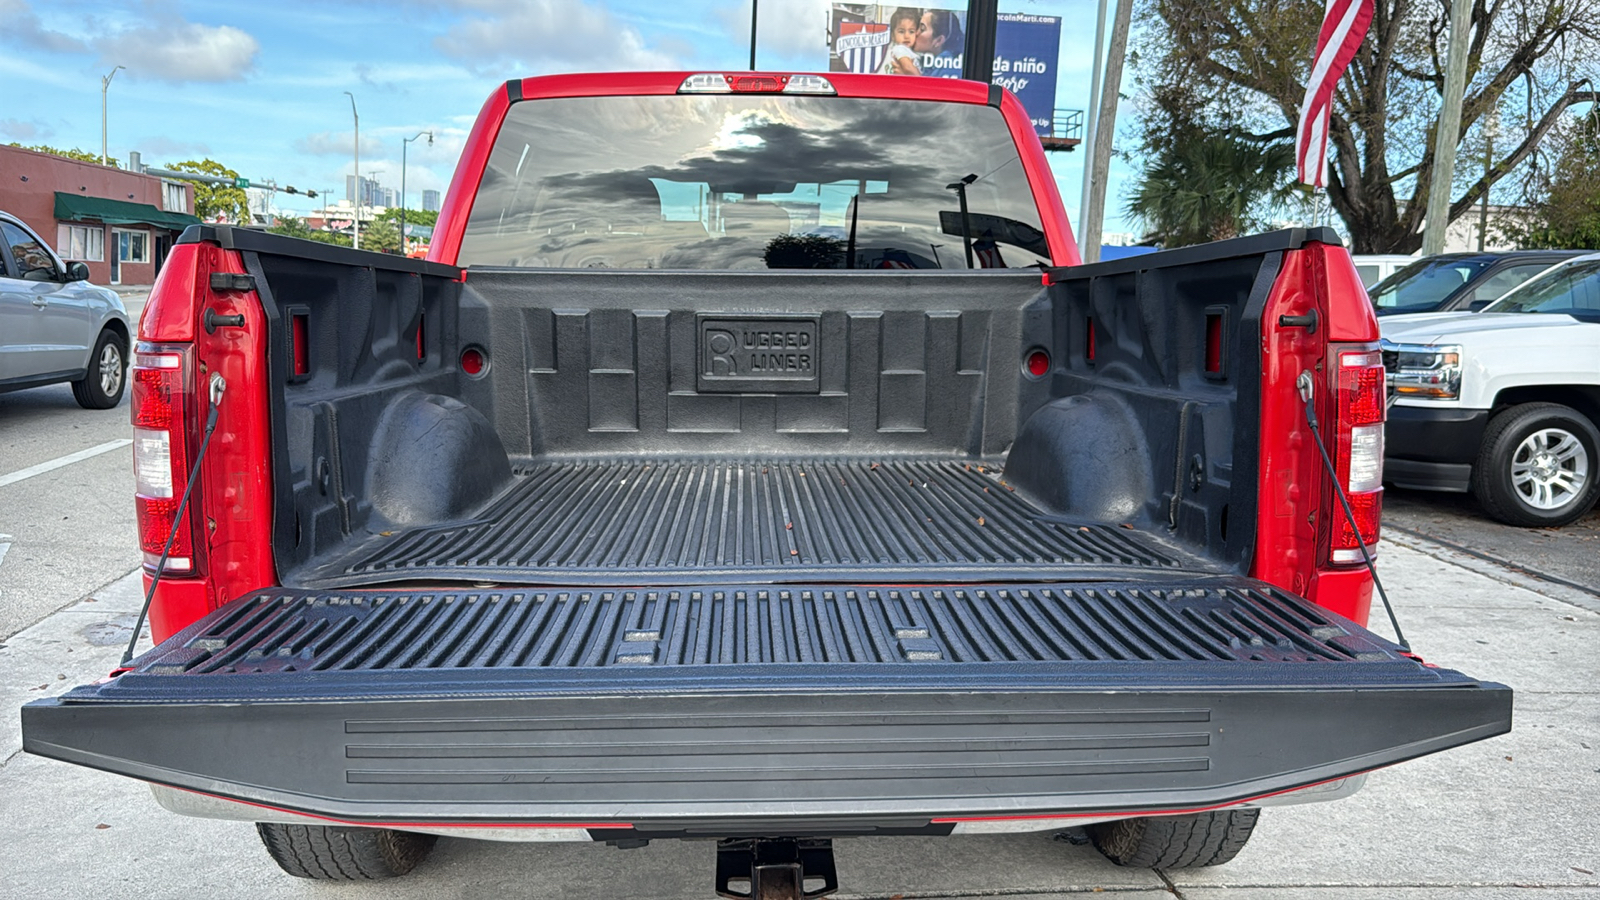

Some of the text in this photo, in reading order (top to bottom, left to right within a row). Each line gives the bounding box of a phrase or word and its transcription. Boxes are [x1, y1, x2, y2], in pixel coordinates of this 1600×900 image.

[923, 53, 1046, 74] Dond da niño
[751, 353, 811, 372] LINER
